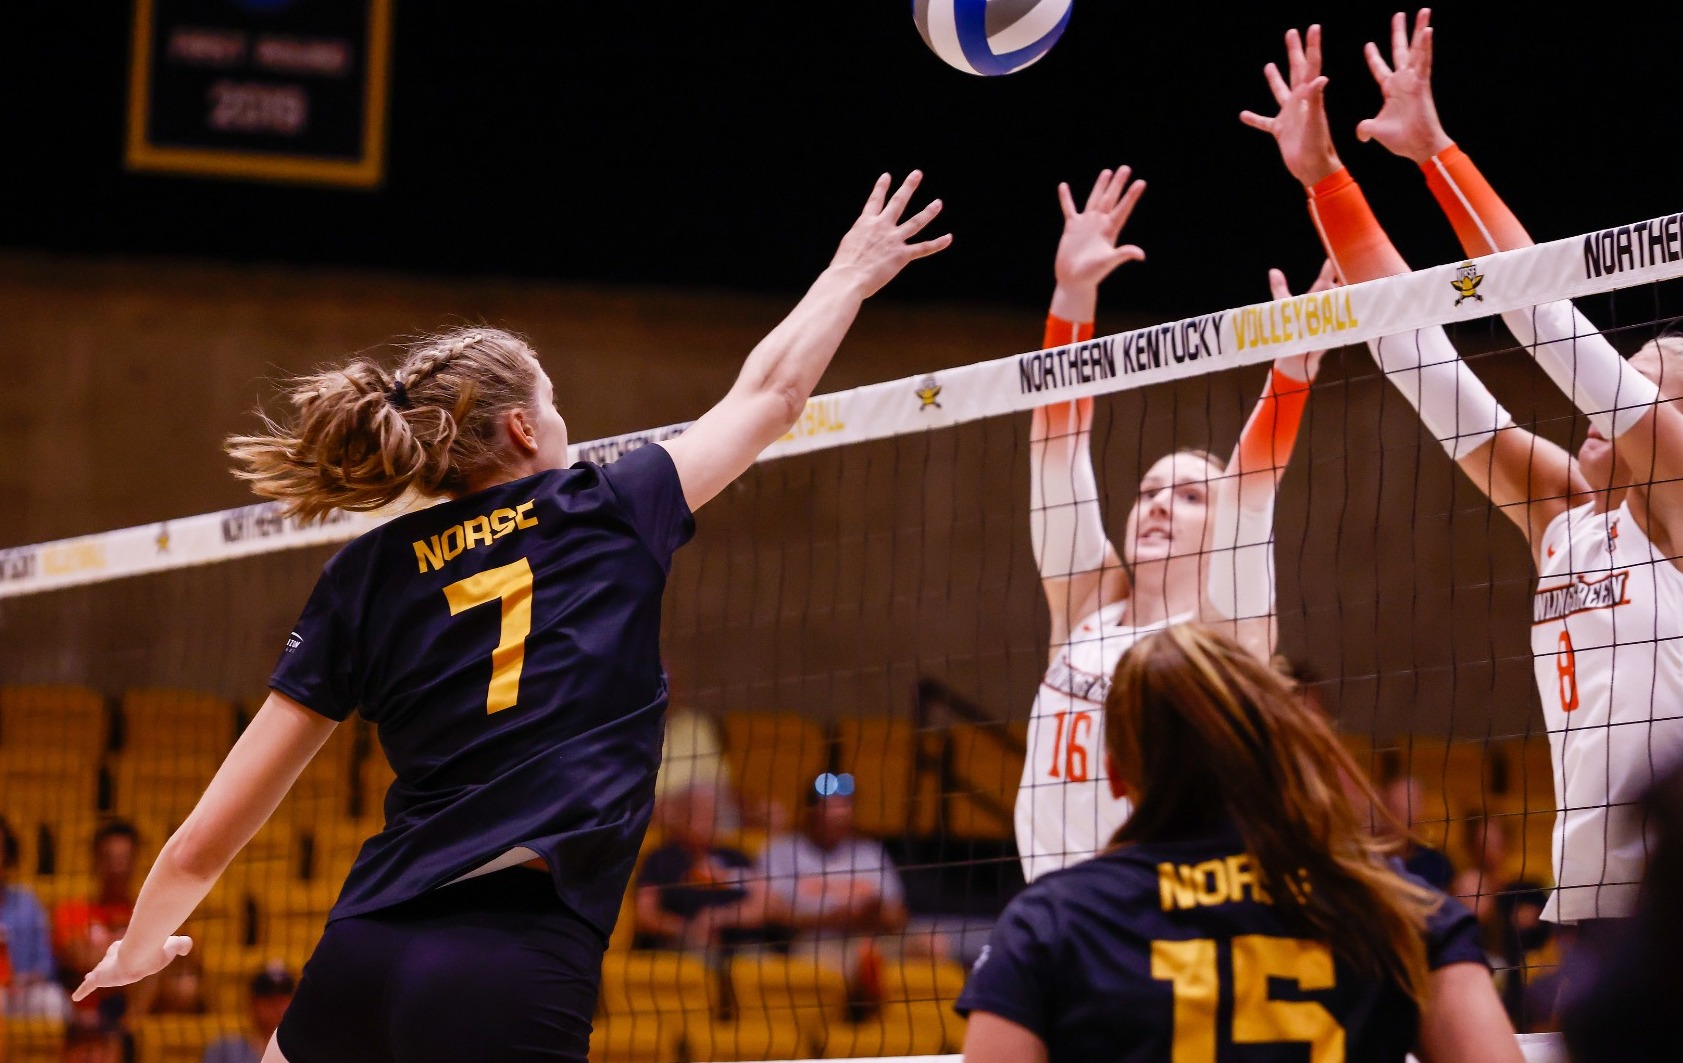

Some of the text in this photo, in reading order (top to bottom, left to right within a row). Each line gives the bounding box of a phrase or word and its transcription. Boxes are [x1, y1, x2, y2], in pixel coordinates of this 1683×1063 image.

[1583, 213, 1683, 280] NORTHE
[1019, 290, 1359, 394] NORTHERN KENTUCKY VOLLEYBALL
[412, 498, 539, 574] NORSE
[442, 556, 534, 716] 7
[1556, 630, 1580, 713] 8
[1048, 708, 1093, 783] 16
[1157, 853, 1313, 912] NOR
[1151, 933, 1347, 1063] 15
